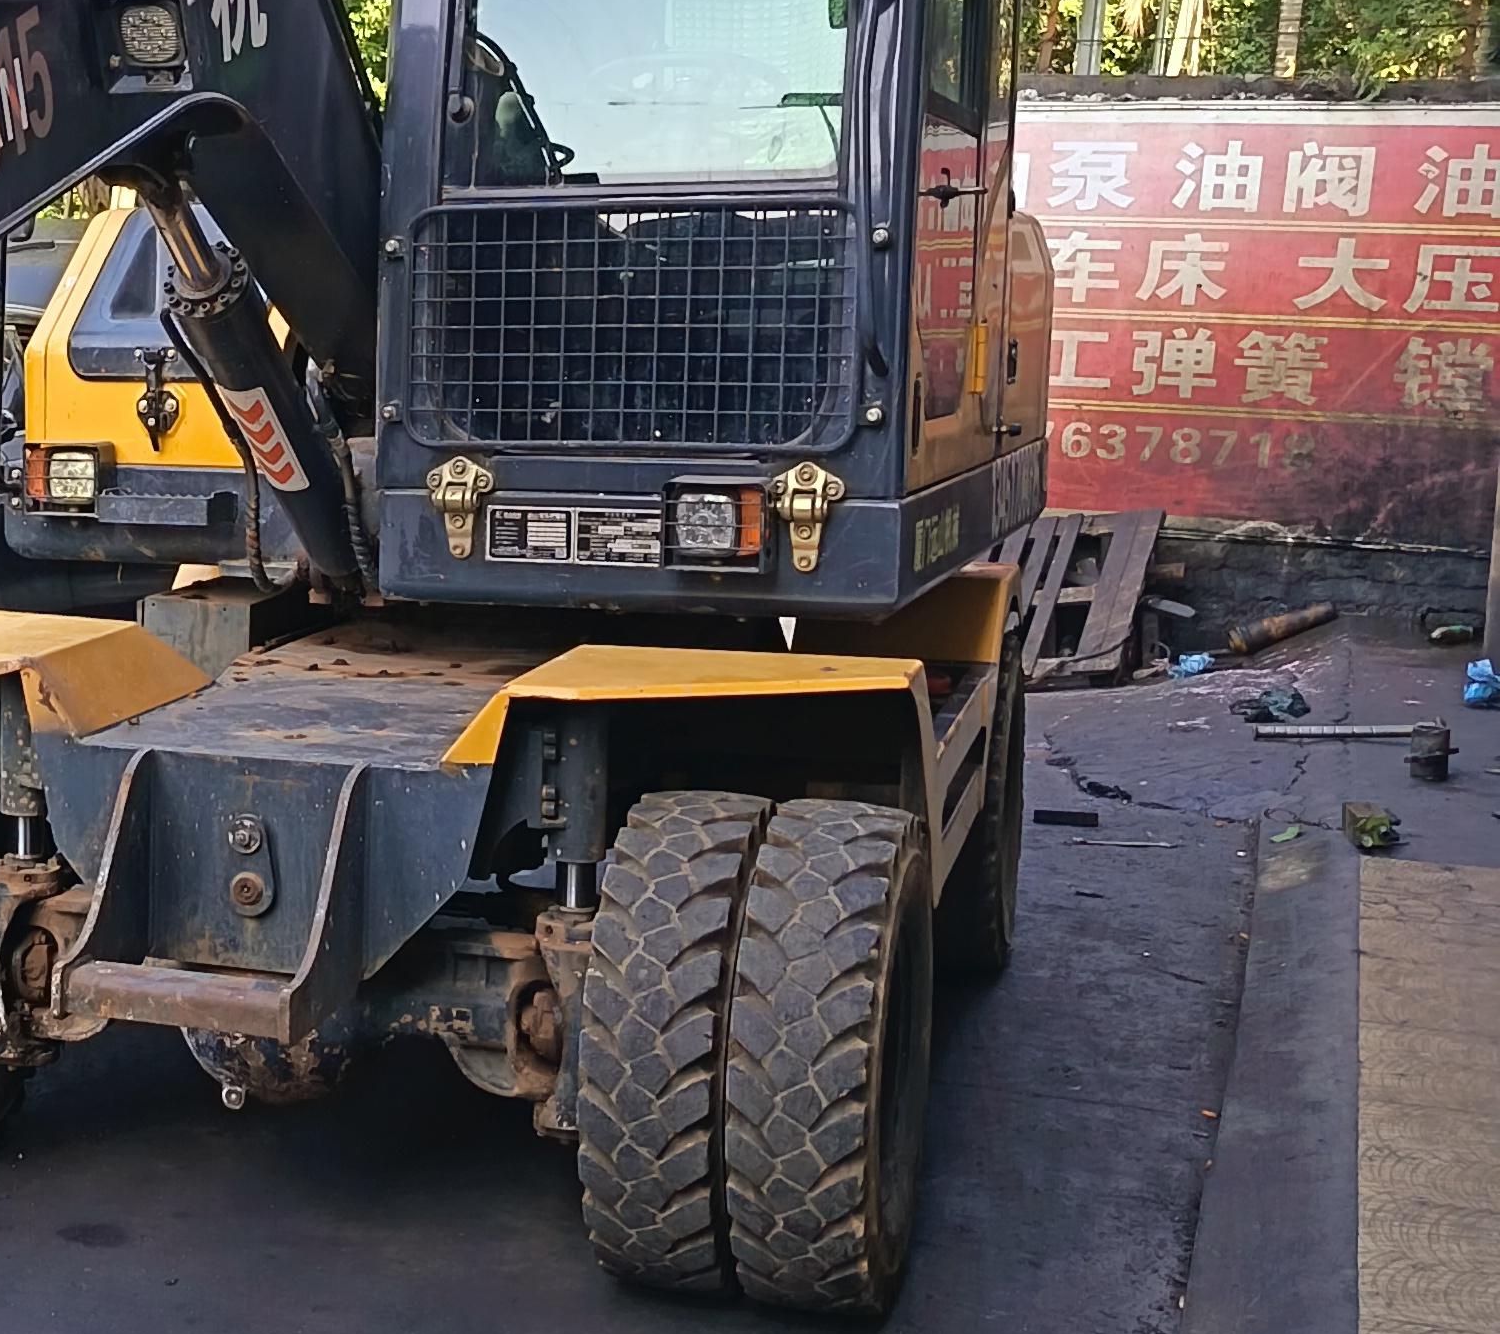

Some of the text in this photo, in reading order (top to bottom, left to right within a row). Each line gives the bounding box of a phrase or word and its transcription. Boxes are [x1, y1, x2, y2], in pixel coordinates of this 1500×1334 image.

[1171, 140, 1377, 218] 油阀
[1048, 230, 1500, 315] 车床 大压
[1048, 327, 1330, 407] 工弹簧
